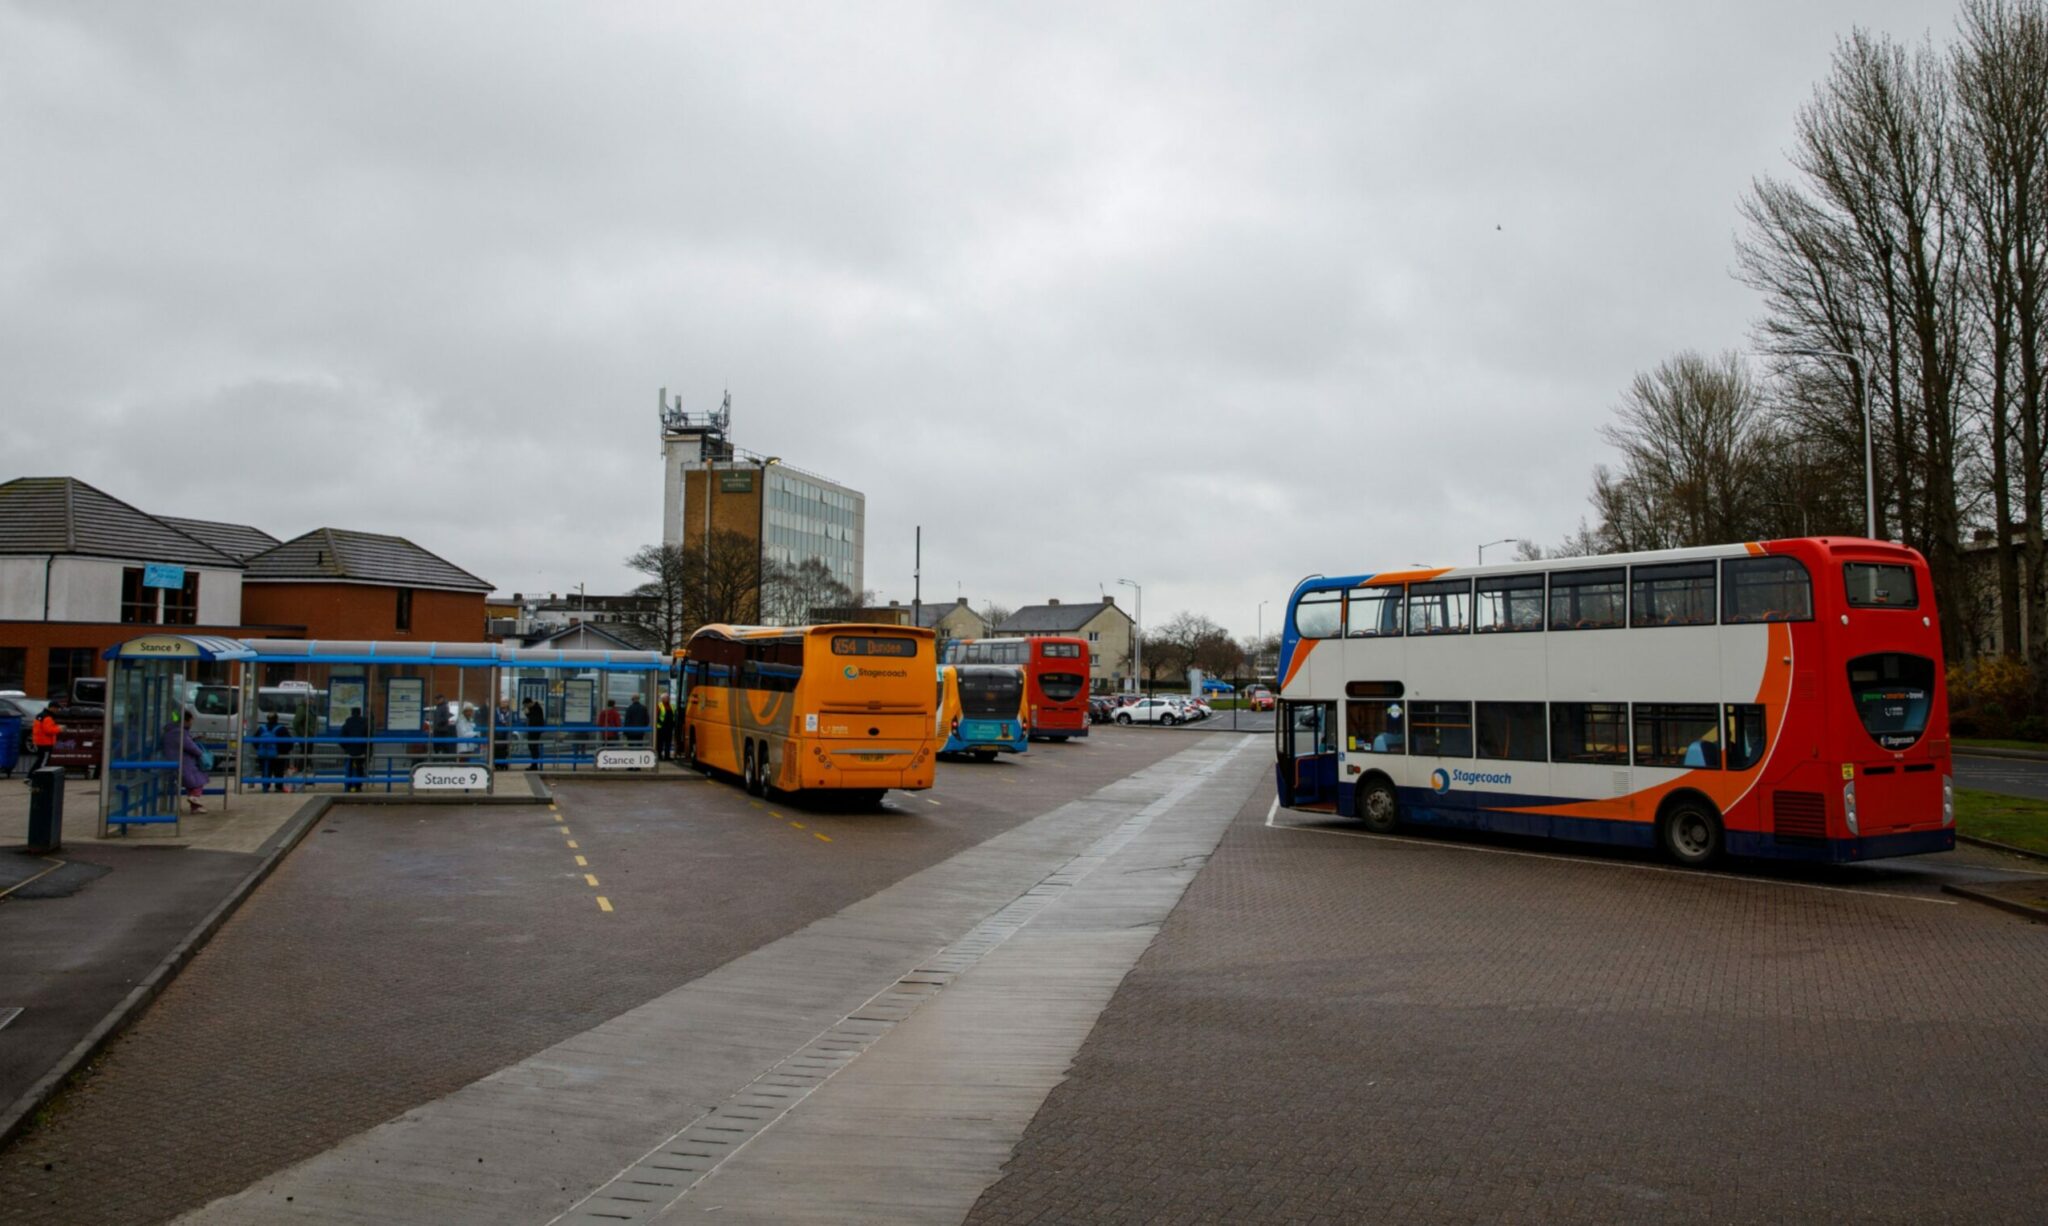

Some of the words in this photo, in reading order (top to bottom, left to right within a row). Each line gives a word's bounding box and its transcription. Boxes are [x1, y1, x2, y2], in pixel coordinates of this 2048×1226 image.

[141, 642, 172, 652] Stance
[174, 643, 181, 652] 9
[834, 638, 857, 654] X54
[867, 639, 902, 655] Dundee
[859, 668, 907, 679] Stagecoach
[603, 755, 635, 765] Stance
[640, 755, 650, 765] 10
[425, 773, 465, 785] Stance
[469, 773, 478, 784] 9
[1453, 768, 1512, 785] Stagecoach
